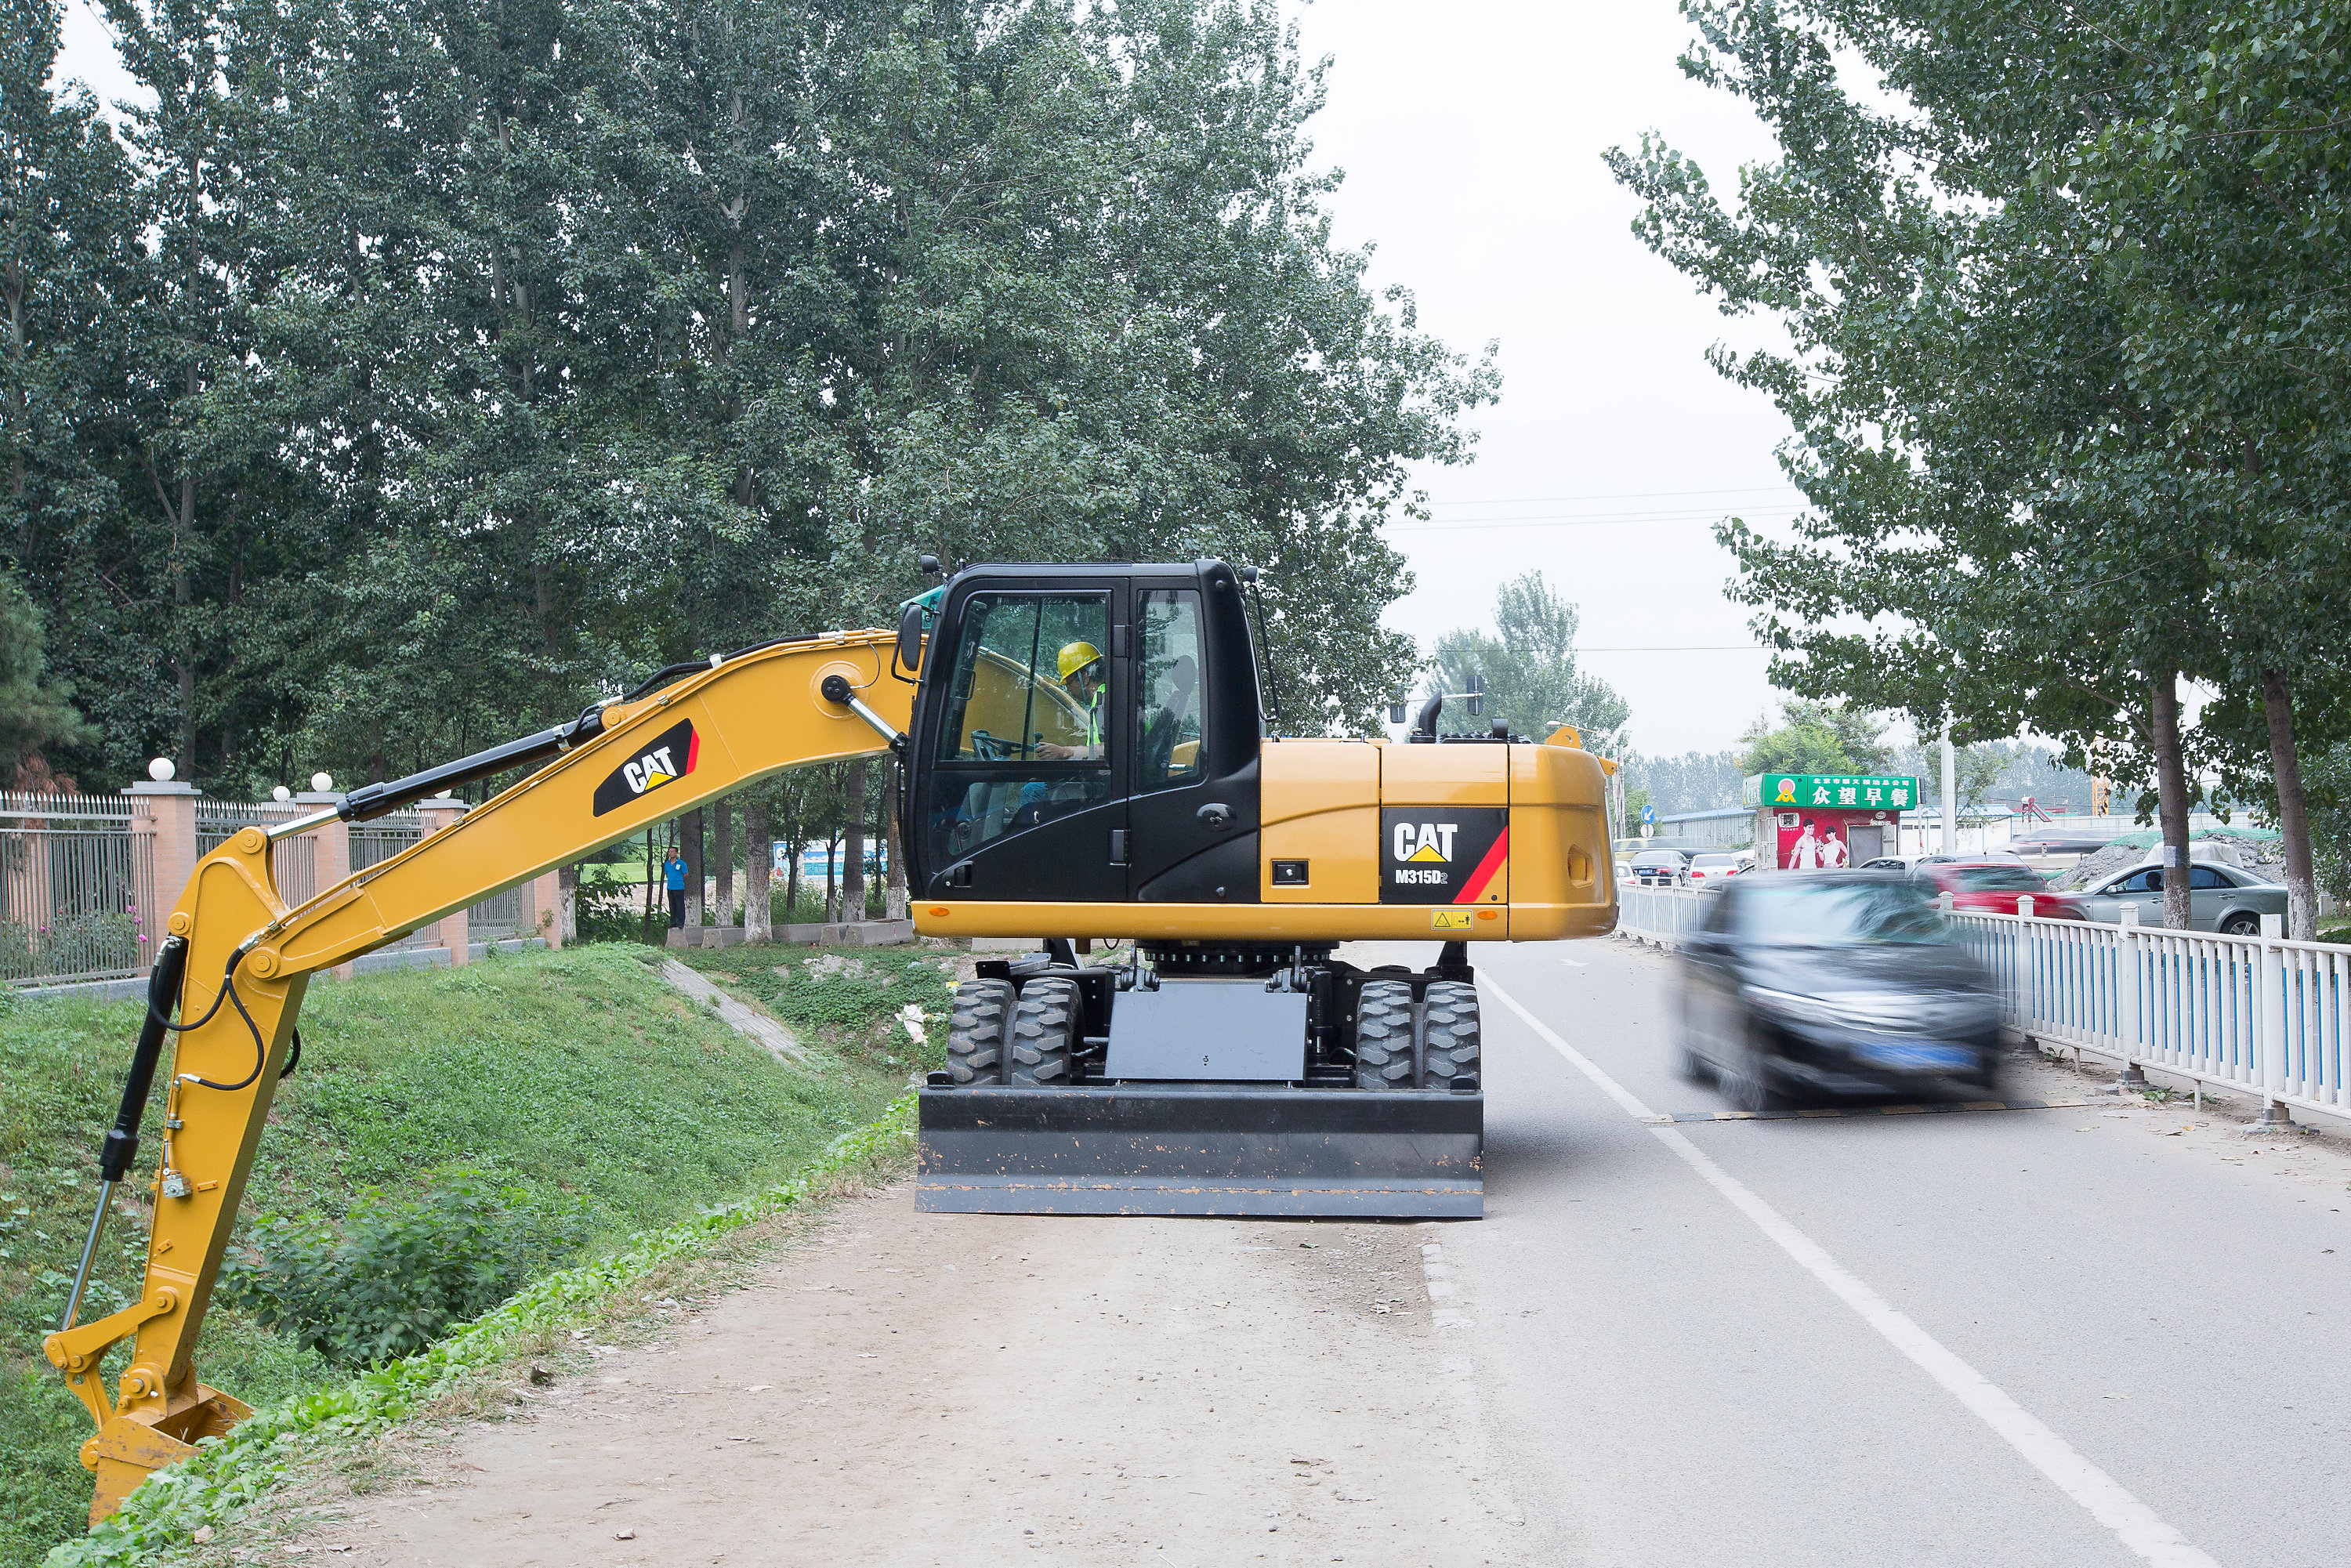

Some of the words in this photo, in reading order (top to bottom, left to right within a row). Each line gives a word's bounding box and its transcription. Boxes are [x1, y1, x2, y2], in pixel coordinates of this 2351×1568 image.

[623, 745, 678, 794] CAT
[1812, 785, 1910, 807] 众望早餐
[1393, 823, 1458, 863] CAT
[1395, 869, 1448, 885] M315D2
